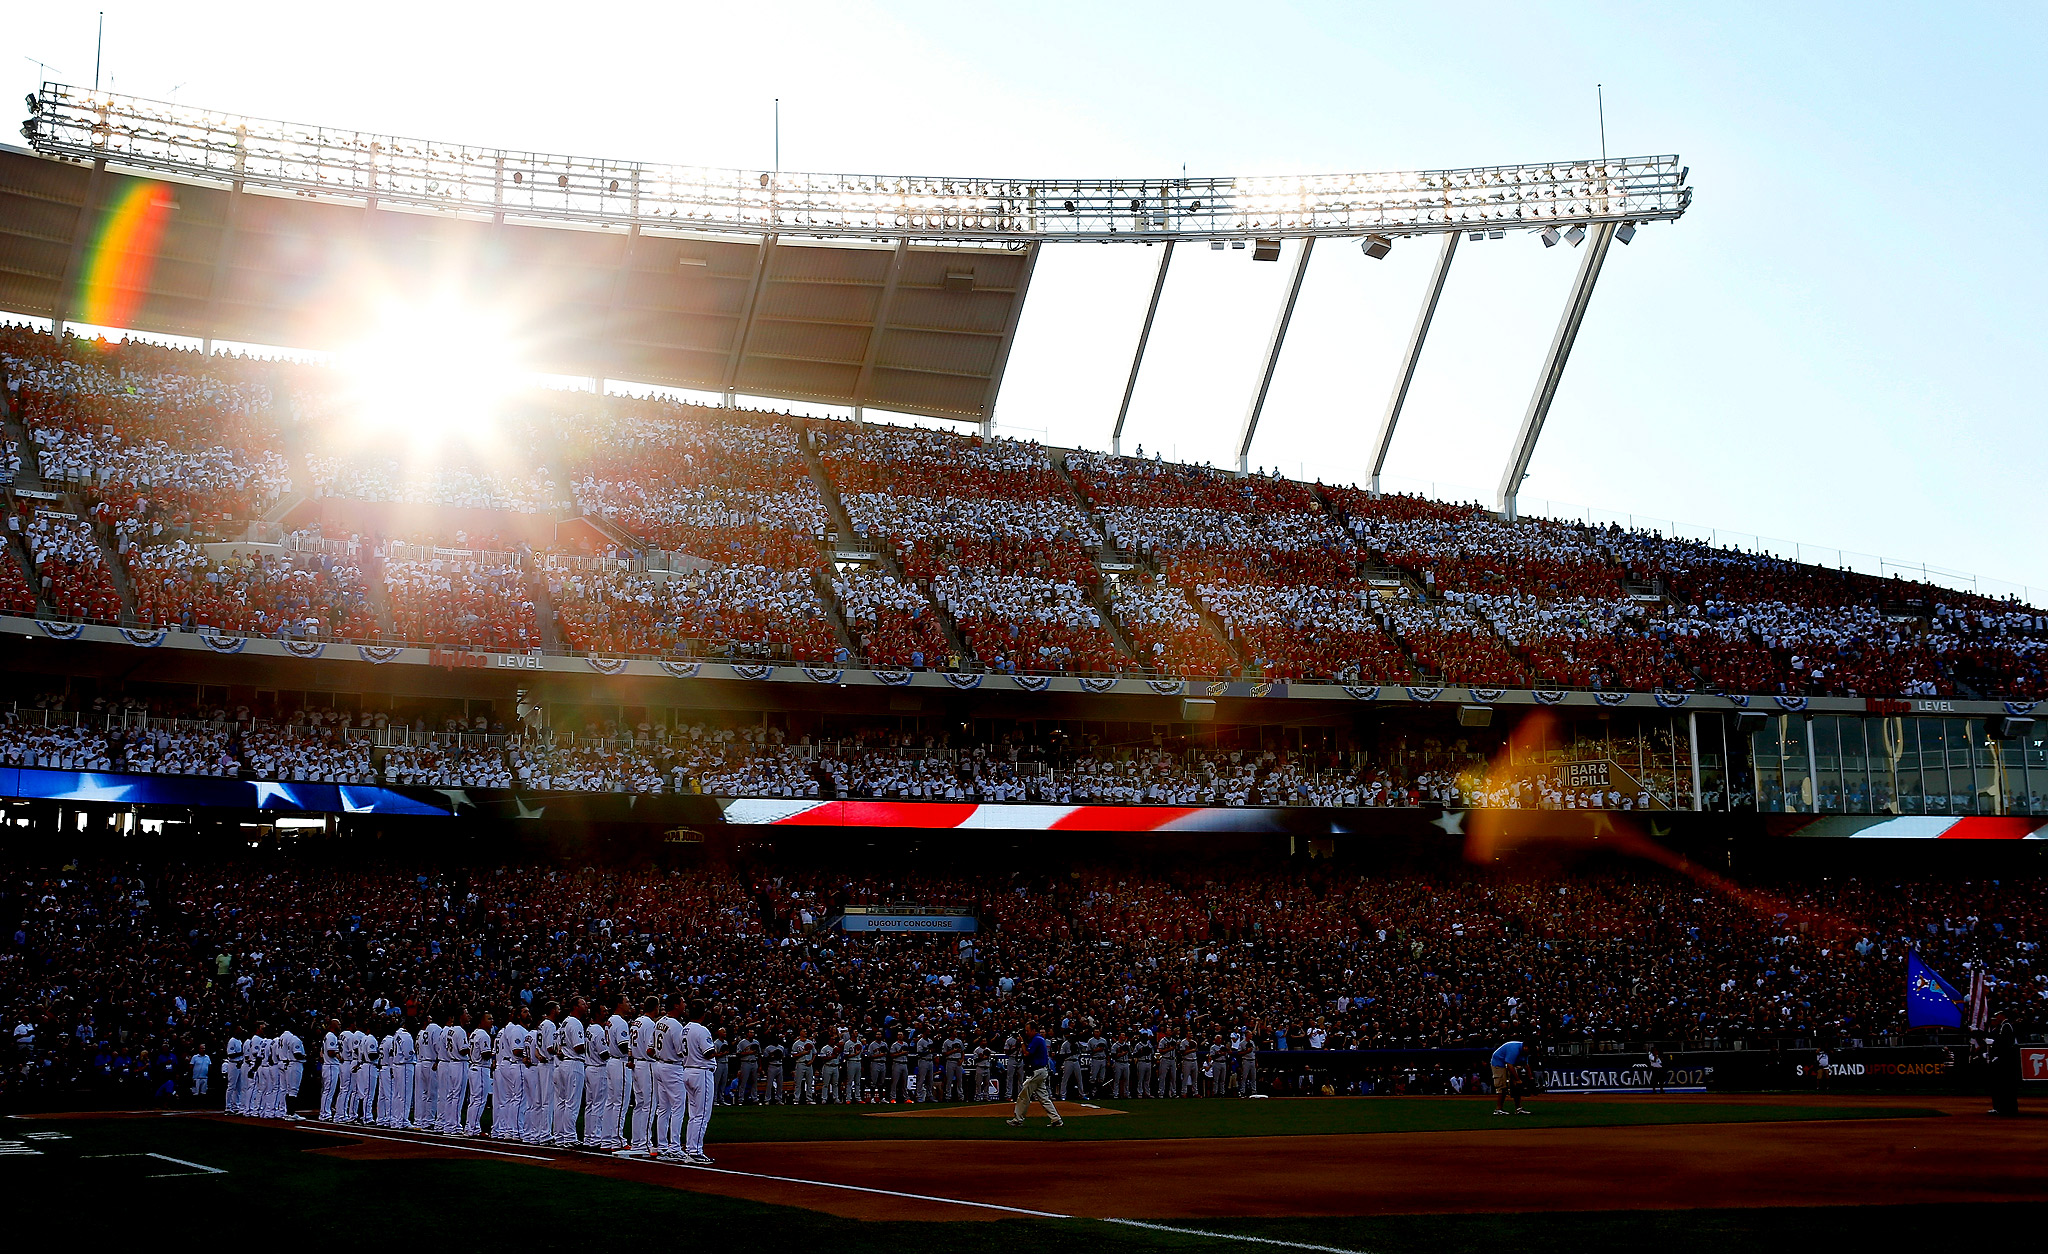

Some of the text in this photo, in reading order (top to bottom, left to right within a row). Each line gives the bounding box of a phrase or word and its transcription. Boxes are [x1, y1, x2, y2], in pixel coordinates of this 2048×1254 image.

[497, 655, 544, 669] LEVEL
[1918, 701, 1955, 712] LEVEL
[1571, 774, 1609, 787] GRILL
[903, 920, 953, 928] CONCOURSE
[1620, 1070, 1653, 1086] GAM
[1666, 1069, 1705, 1085] 2012
